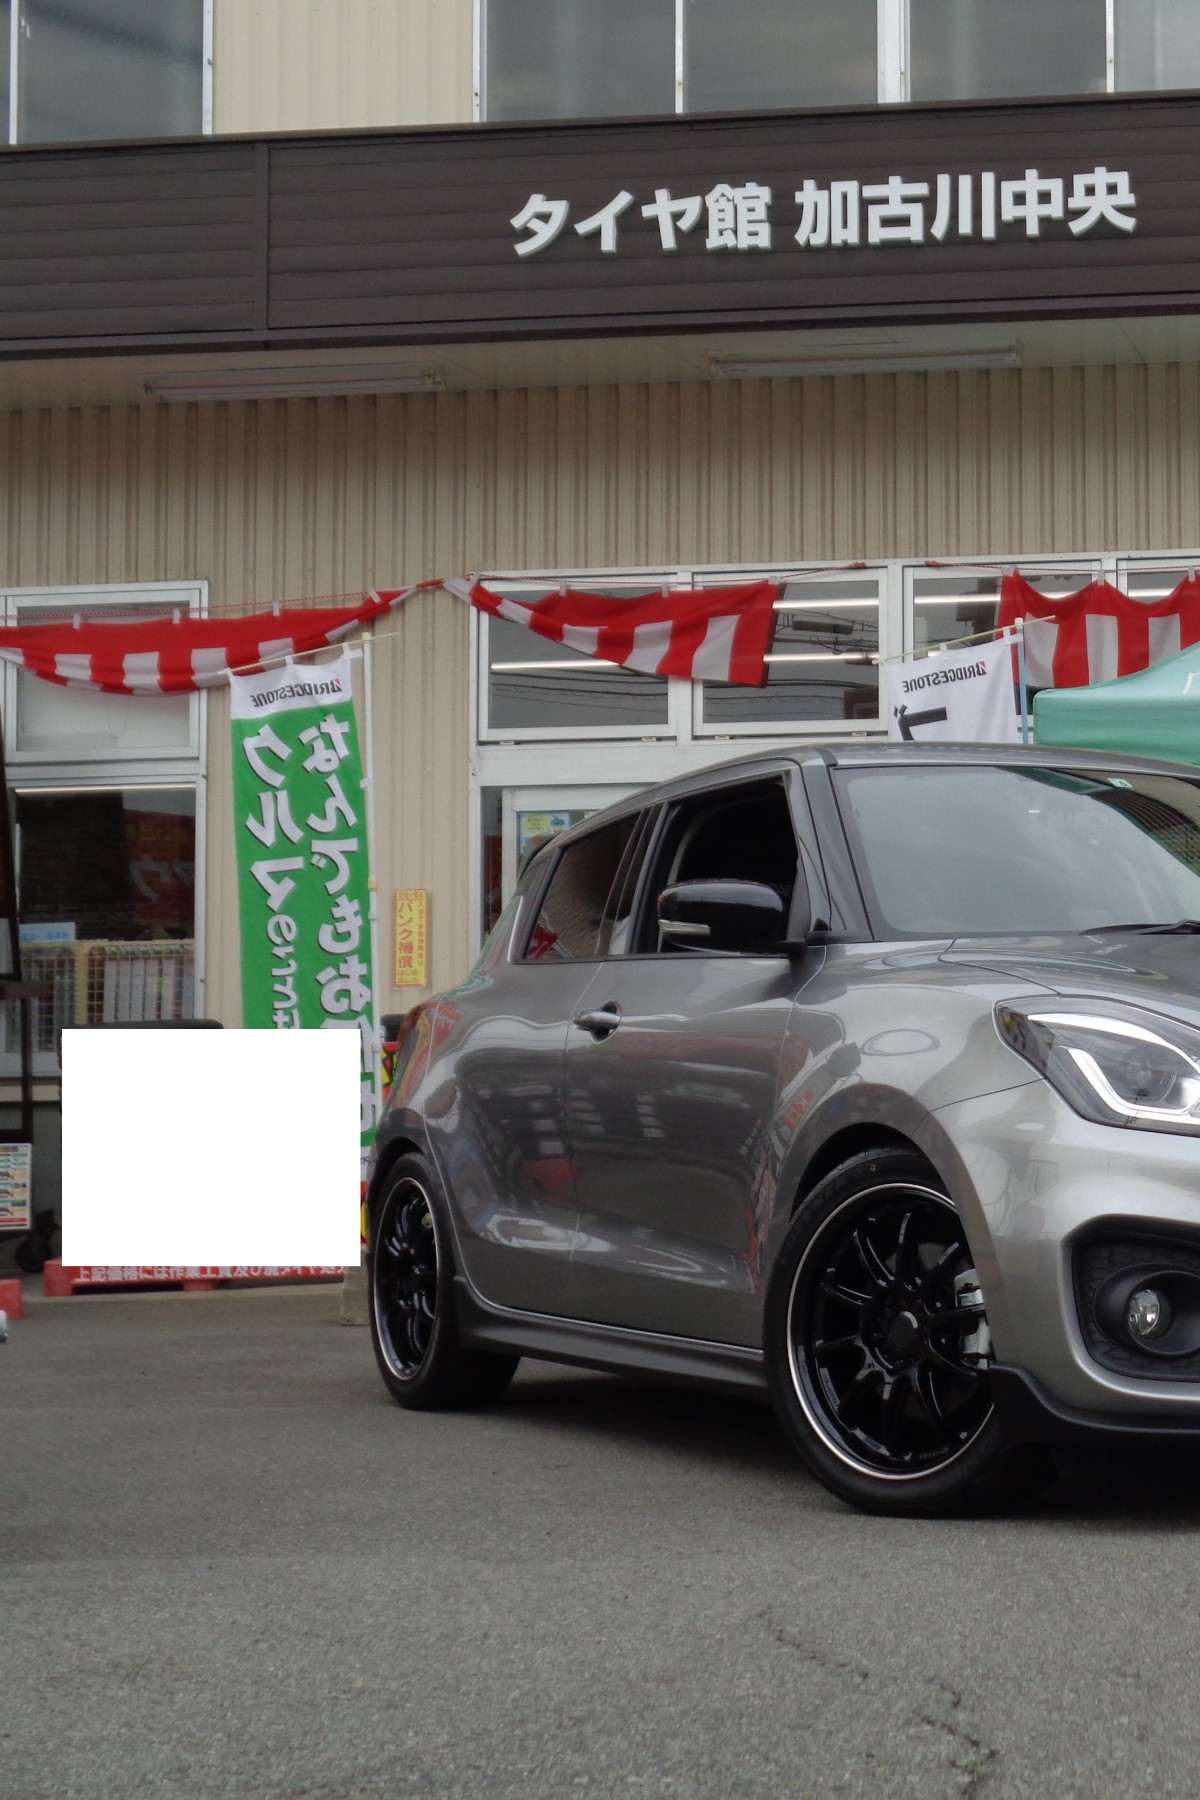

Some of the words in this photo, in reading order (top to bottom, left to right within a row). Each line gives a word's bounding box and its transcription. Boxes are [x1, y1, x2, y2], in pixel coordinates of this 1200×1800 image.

[510, 182, 772, 257] タイヤ館
[793, 166, 1138, 248] 加古川中央
